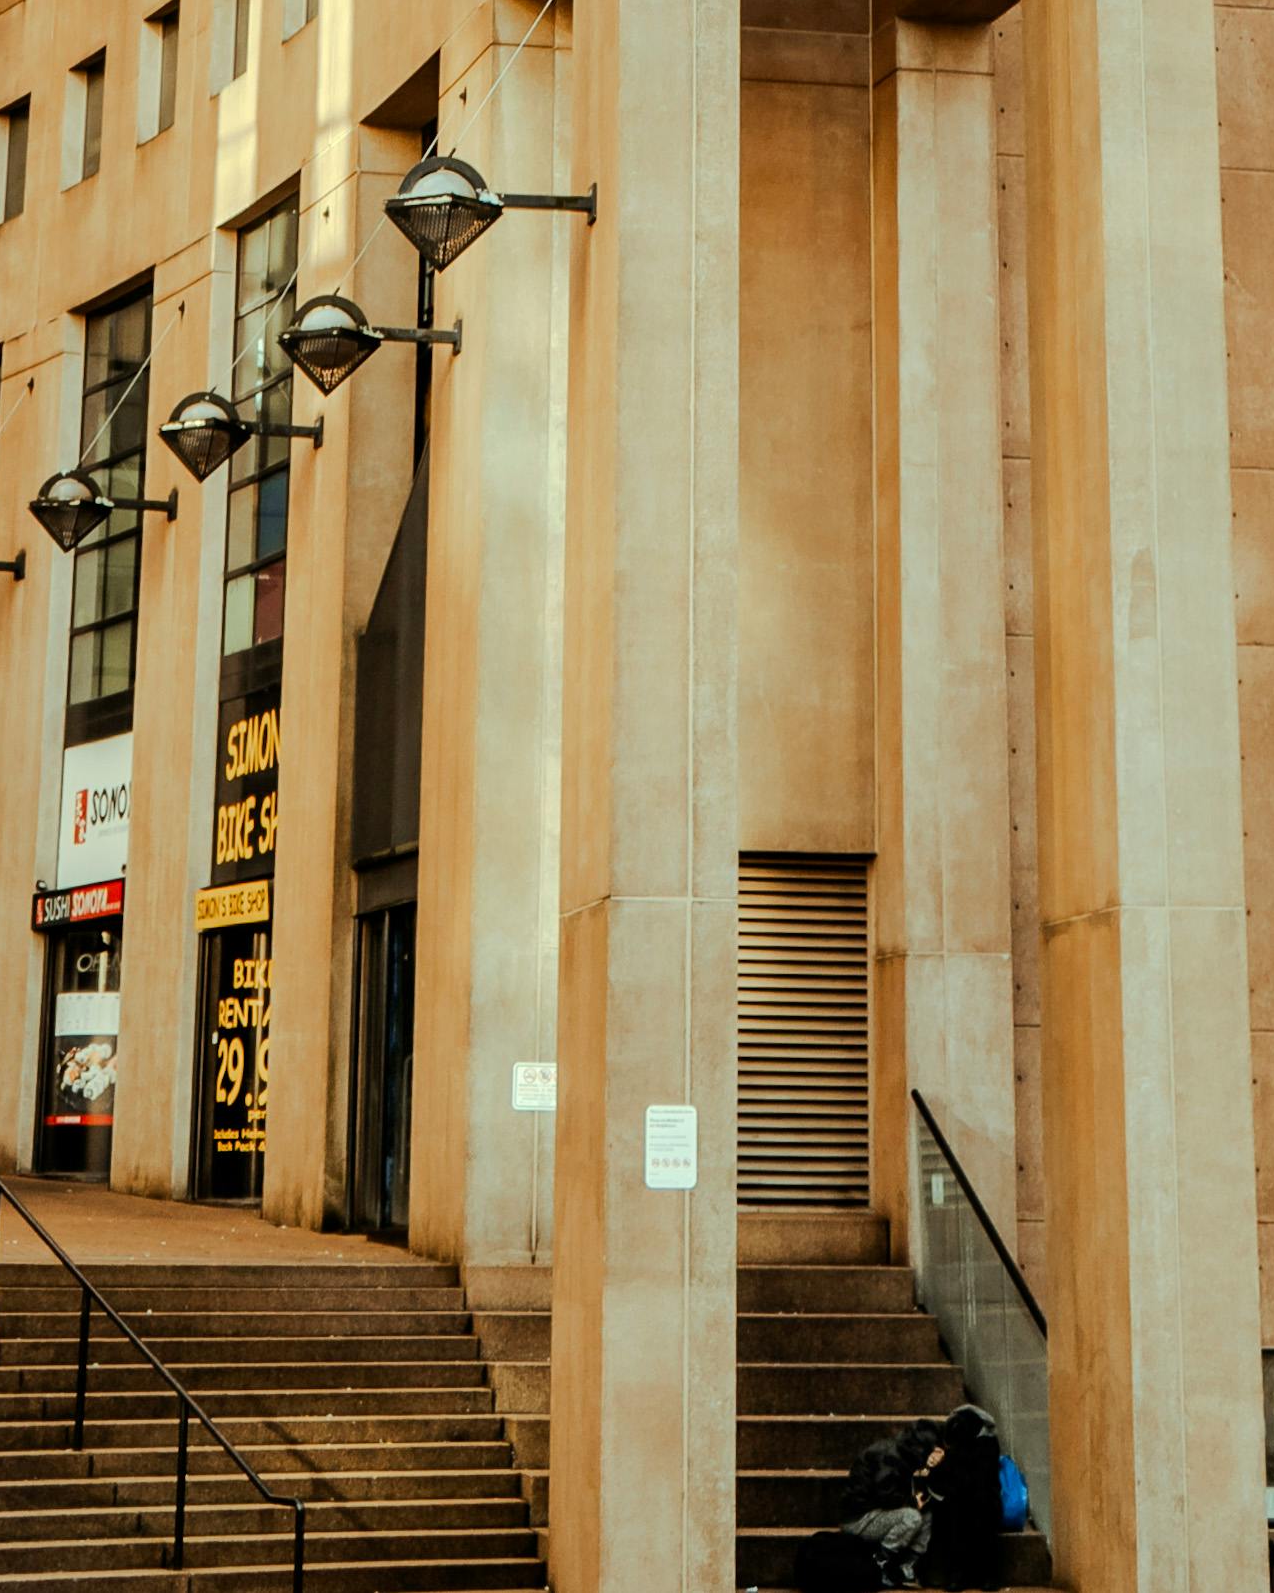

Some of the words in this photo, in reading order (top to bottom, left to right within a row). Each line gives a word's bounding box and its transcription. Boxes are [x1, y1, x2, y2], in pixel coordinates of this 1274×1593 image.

[90, 783, 131, 825] SONO
[216, 795, 256, 865] BIKE
[44, 895, 71, 922] SUSHI
[229, 891, 244, 916] BIKE
[247, 888, 265, 914] SHOP
